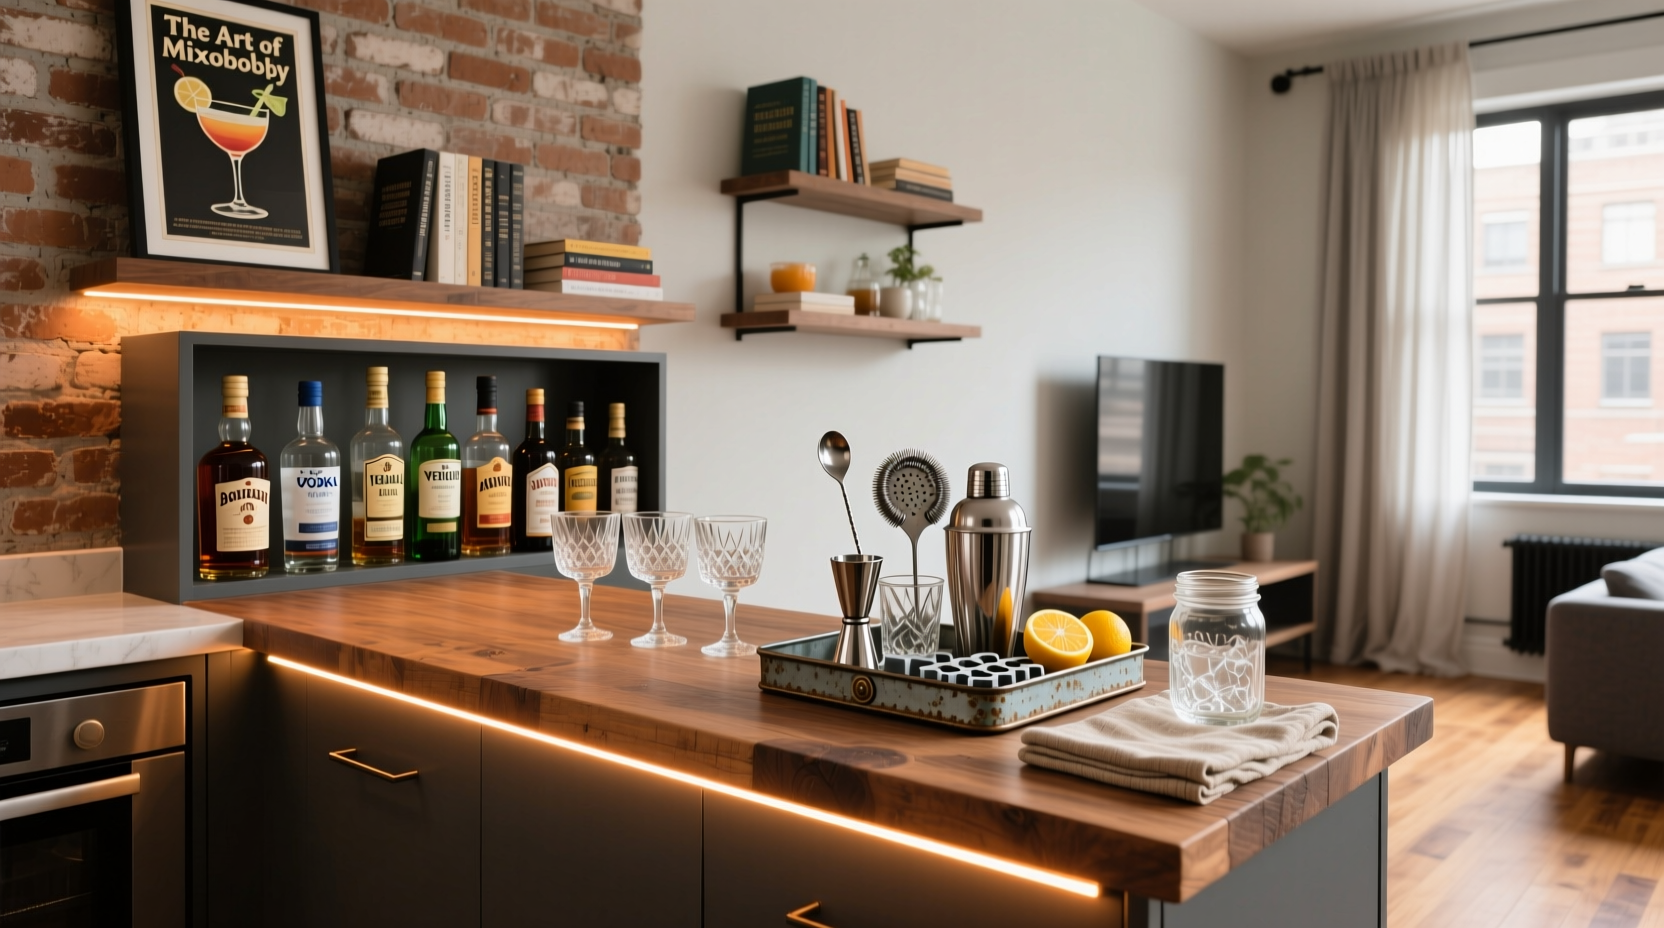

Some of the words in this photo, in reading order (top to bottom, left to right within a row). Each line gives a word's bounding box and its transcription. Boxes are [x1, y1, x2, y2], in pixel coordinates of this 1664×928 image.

[163, 14, 210, 42] The
[215, 26, 254, 51] Art
[259, 36, 284, 57] of
